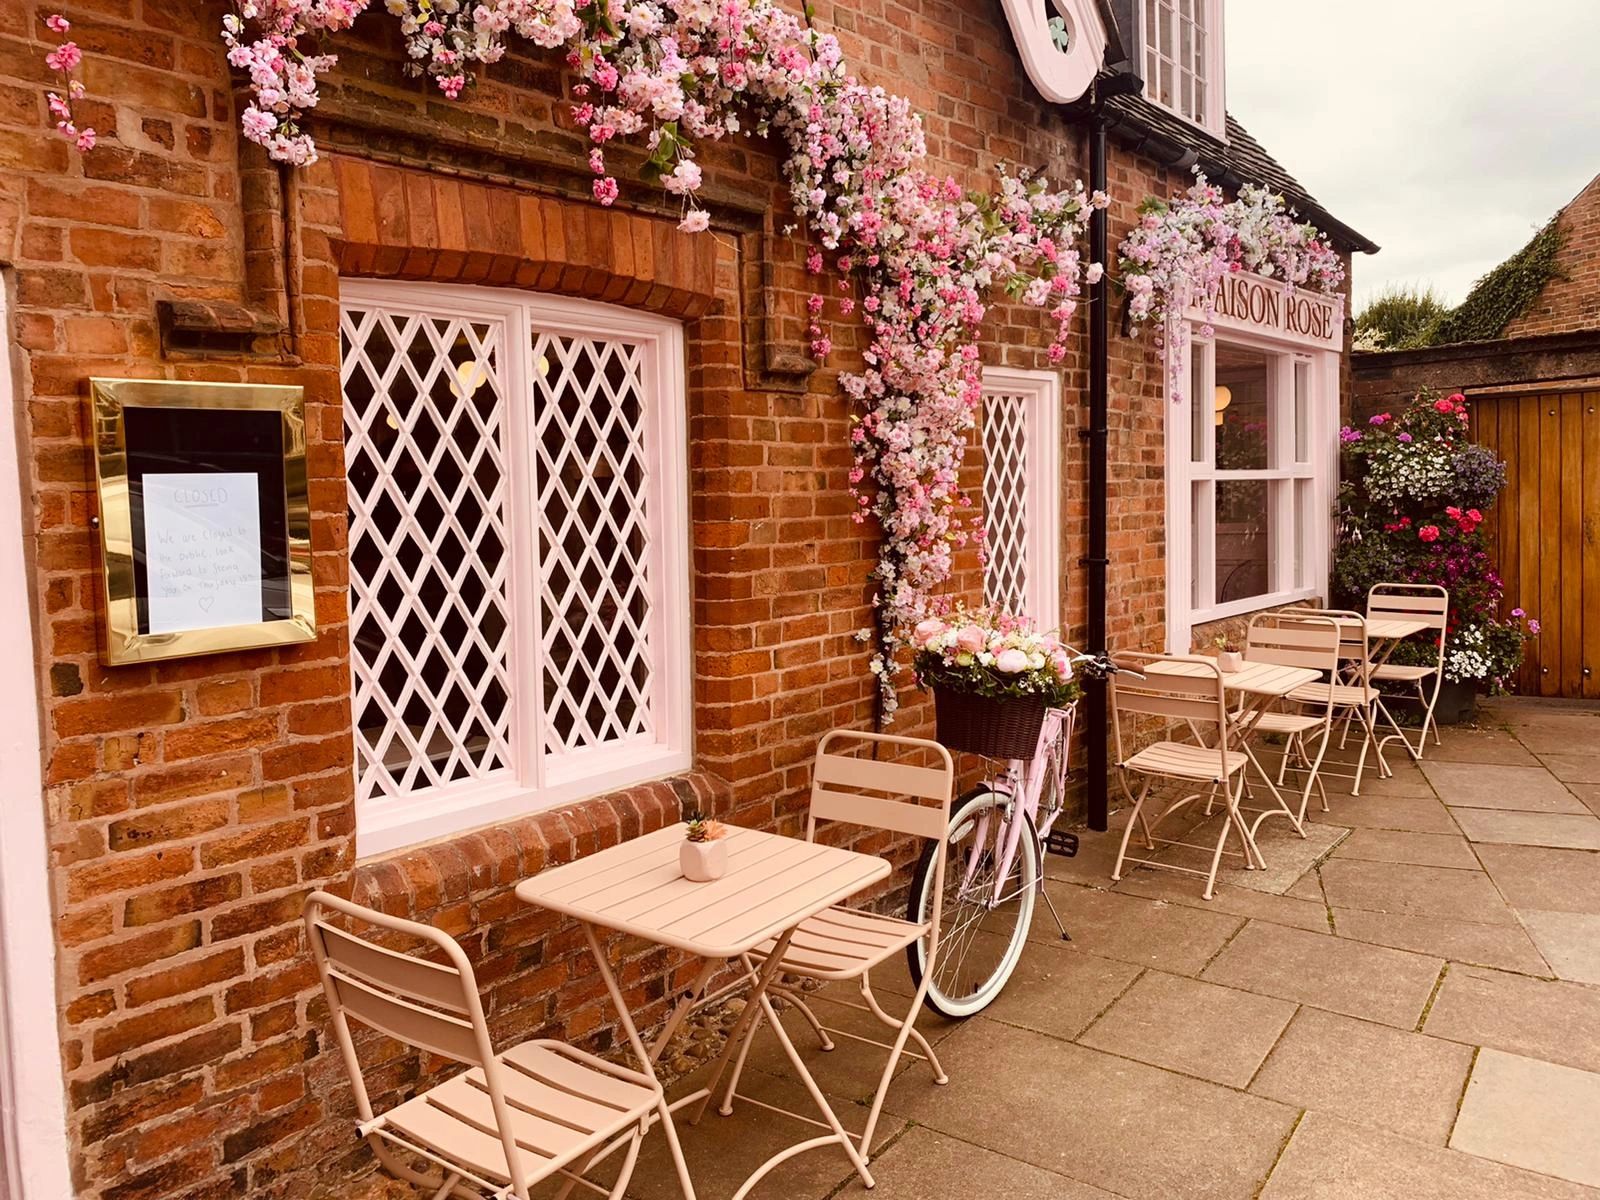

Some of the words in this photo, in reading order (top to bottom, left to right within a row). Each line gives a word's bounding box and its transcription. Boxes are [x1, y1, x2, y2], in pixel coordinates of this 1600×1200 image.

[1287, 296, 1334, 340] ROSE
[174, 487, 228, 503] CLOSED
[158, 528, 174, 544] We
[183, 534, 196, 543] are
[238, 526, 247, 536] to
[160, 552, 172, 561] the
[198, 564, 207, 574] to
